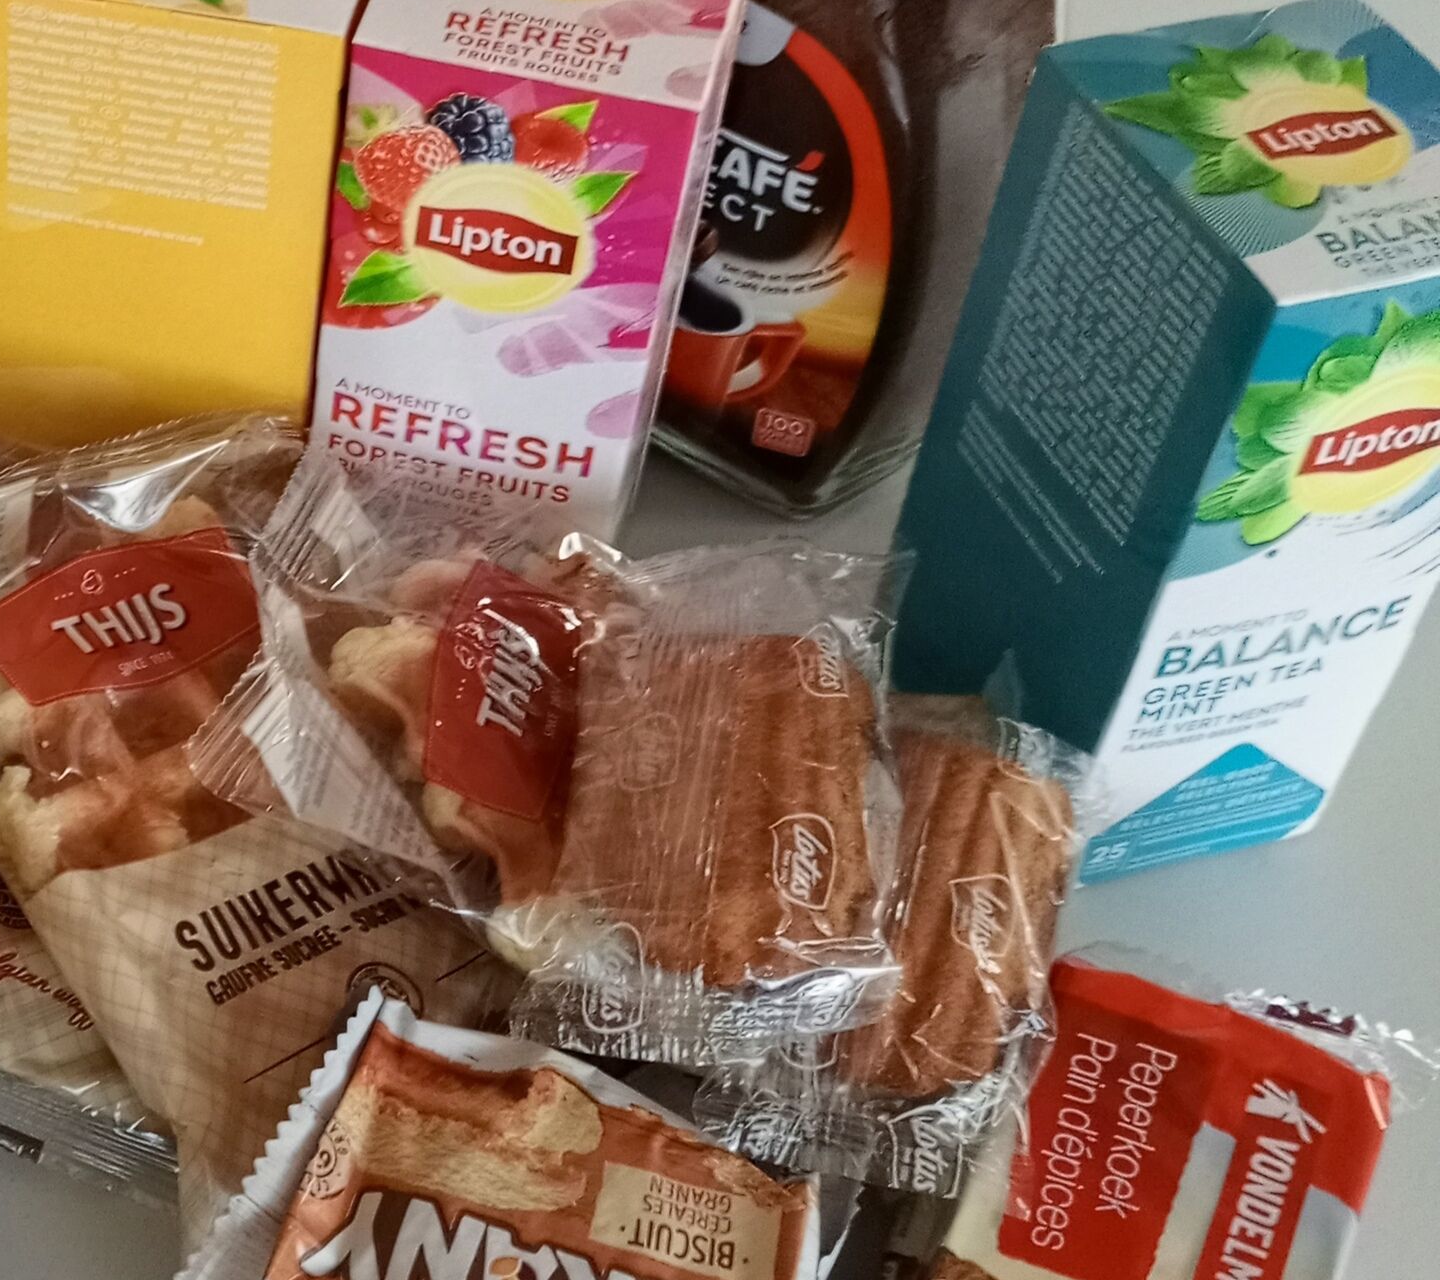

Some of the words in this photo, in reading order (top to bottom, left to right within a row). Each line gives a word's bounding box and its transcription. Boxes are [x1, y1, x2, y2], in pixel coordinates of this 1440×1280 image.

[443, 32, 535, 59] FOREST
[540, 49, 624, 77] FRUITS
[445, 11, 631, 64] REFRESH
[1259, 117, 1385, 154] Lipton
[428, 212, 563, 267] Lipton
[335, 377, 349, 391] A
[353, 381, 441, 414] MOMENT
[444, 403, 472, 421] TO
[328, 390, 596, 479] REFRESH
[765, 414, 805, 436] 100
[1312, 418, 1440, 468] Lipton
[458, 466, 572, 505] FRUITS
[50, 582, 188, 655] THIJS
[1153, 594, 1414, 681] BALANCE
[1143, 672, 1258, 706] GREEN
[1269, 656, 1324, 684] TEA
[1136, 694, 1224, 725] MINT
[1088, 840, 1131, 866] 25
[205, 957, 279, 1008] GAUFRE
[1062, 1031, 1120, 1107] Pain
[1093, 1041, 1180, 1219] Peperkoek
[649, 1174, 733, 1215] GRANEN
[1030, 1106, 1102, 1252] d'épices
[626, 1217, 737, 1271] BISCUIT
